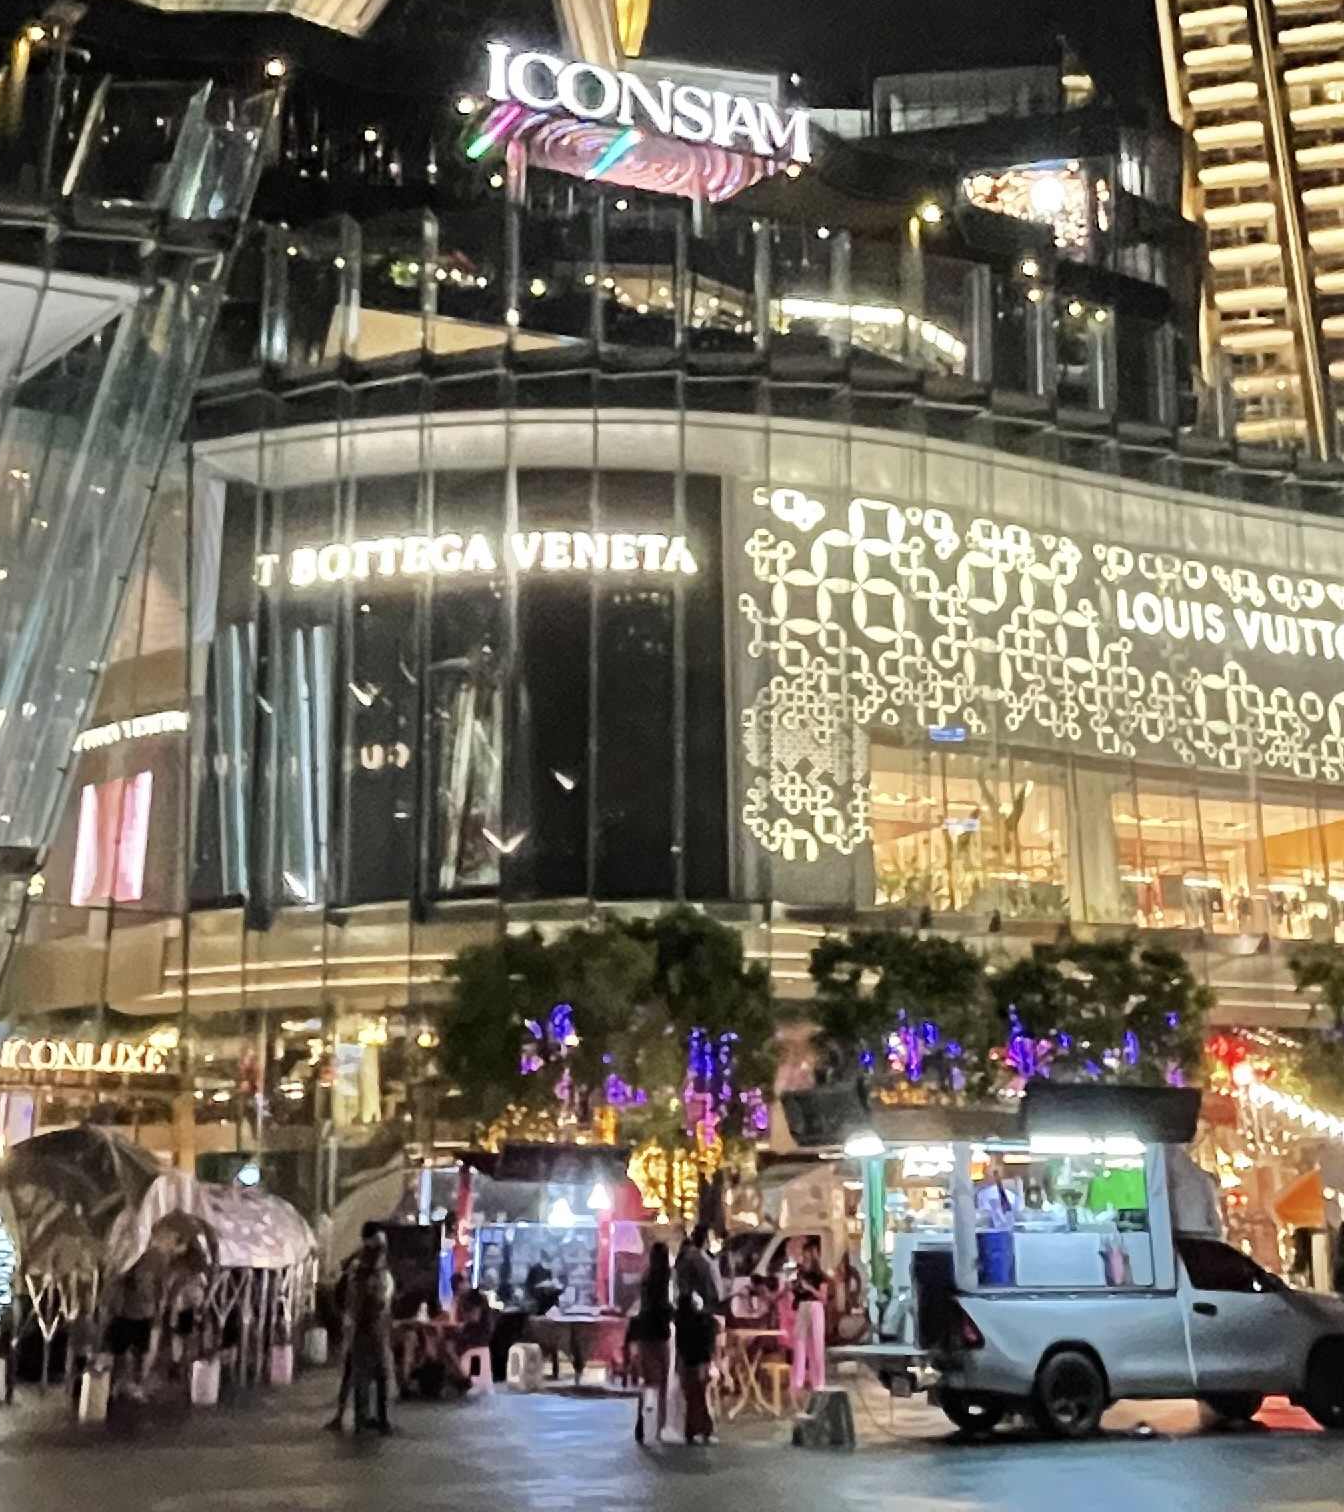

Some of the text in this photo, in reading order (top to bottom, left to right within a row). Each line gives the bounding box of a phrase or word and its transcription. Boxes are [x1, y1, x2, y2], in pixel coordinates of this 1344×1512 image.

[486, 41, 812, 164] ICONSIAM
[290, 533, 498, 587] BOTTEGA
[511, 531, 698, 574] VENETA
[1116, 588, 1227, 644] LOUIS
